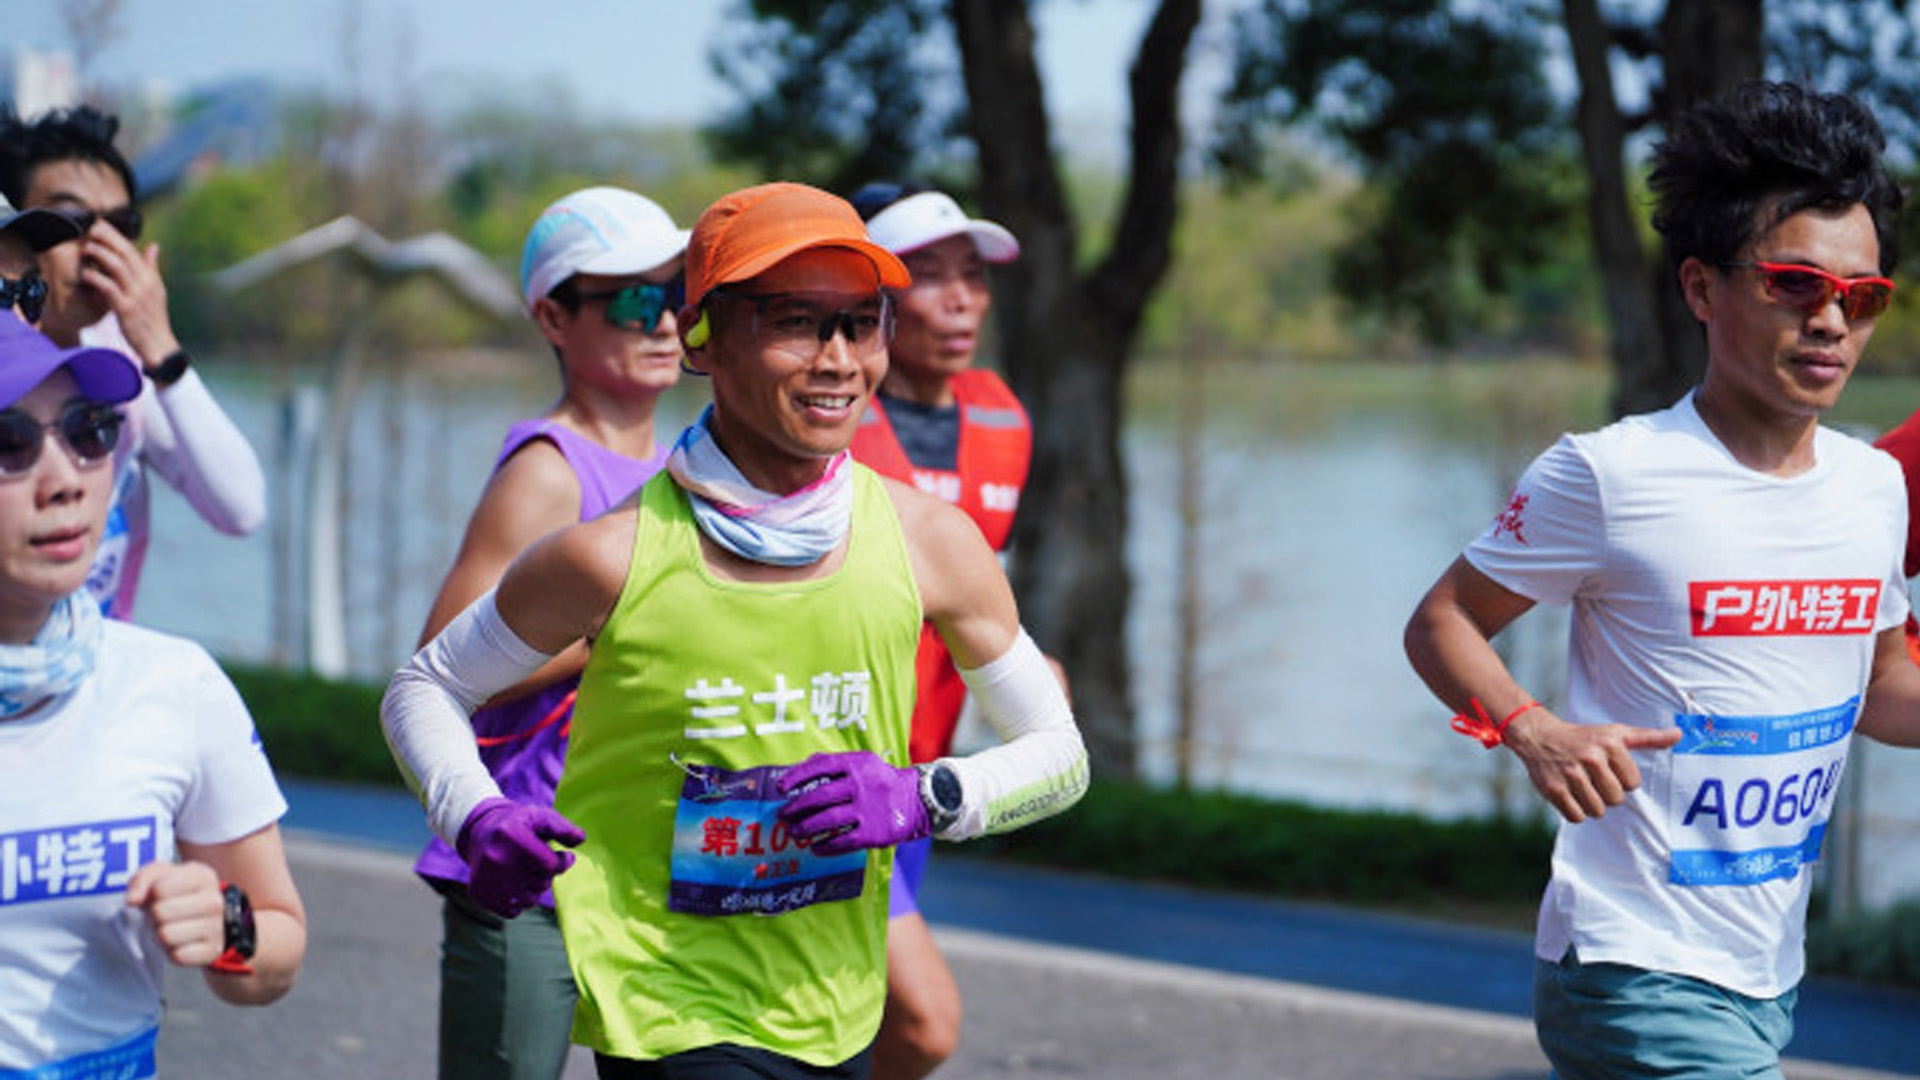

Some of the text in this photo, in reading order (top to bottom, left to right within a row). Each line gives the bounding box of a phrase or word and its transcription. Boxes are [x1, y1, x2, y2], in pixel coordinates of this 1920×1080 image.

[1701, 585, 1878, 632] 户外特工
[684, 671, 871, 739] 兰士顿
